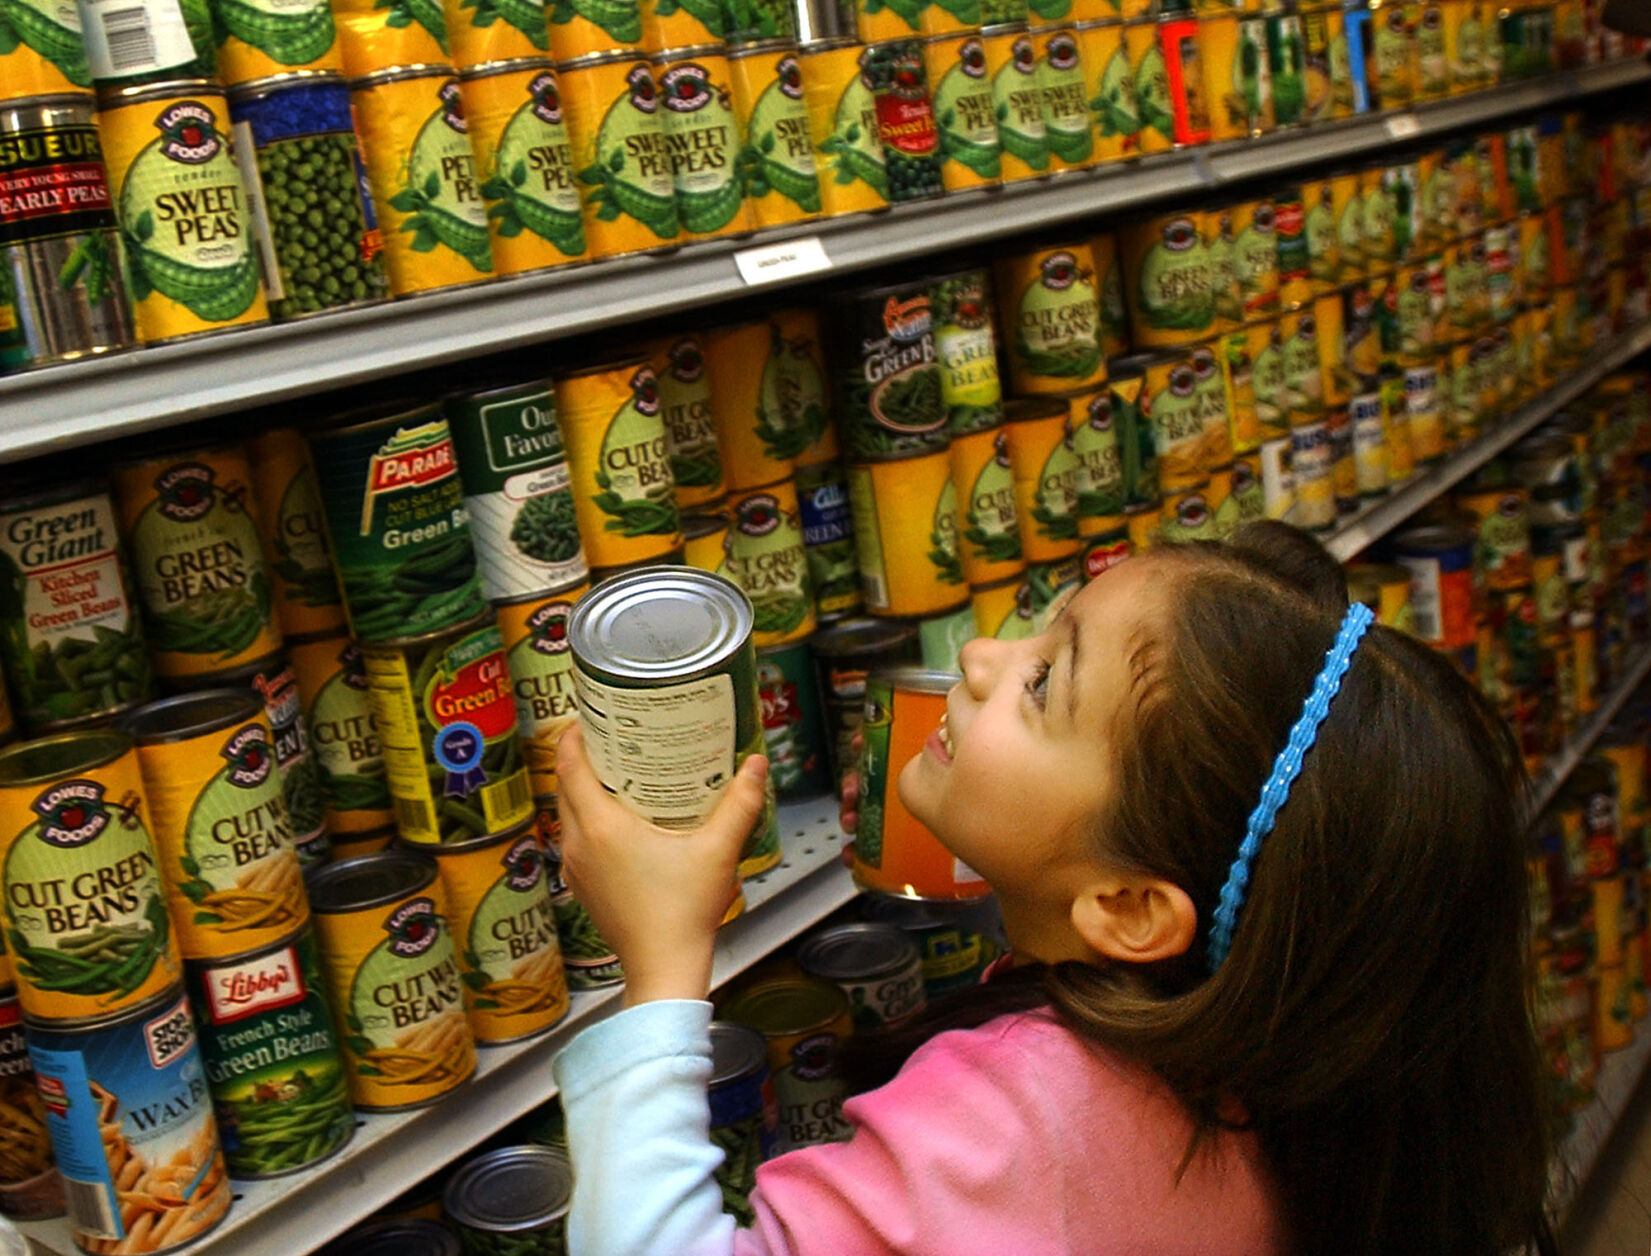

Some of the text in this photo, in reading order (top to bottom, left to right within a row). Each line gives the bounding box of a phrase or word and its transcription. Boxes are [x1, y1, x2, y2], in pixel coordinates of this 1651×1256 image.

[1010, 89, 1043, 109] SWE
[162, 106, 212, 128] LOWES
[776, 117, 811, 140] SWE
[0, 134, 100, 166] SUEUR
[168, 139, 219, 158] FOODS
[528, 144, 571, 170] SWE
[625, 132, 665, 157] SWE
[788, 136, 814, 159] PEA
[671, 149, 727, 176] PEAS
[455, 178, 481, 203] PE
[543, 167, 577, 191] PEA
[0, 185, 107, 214] EARLY PEAS
[155, 185, 240, 222] SWEET
[175, 211, 241, 247] PEAS
[864, 343, 922, 383] GREEN
[944, 344, 993, 371] GREE
[951, 362, 999, 387] BEAN
[673, 419, 716, 444] BEAN
[379, 445, 450, 485] PARADE
[606, 440, 648, 470] CUT
[161, 467, 211, 489] LOWES
[638, 463, 671, 487] BEA
[168, 496, 214, 518] FOODS
[8, 507, 96, 545] Green
[286, 512, 320, 537] CU
[383, 520, 448, 549] Green
[804, 523, 844, 543] REEN
[20, 527, 108, 568] Giant
[156, 541, 244, 578] GREEN
[39, 569, 101, 593] Kitchen
[162, 562, 248, 604] BEANS
[51, 584, 98, 608] Sliced
[28, 606, 79, 629] Green
[81, 598, 121, 621] Beans
[478, 660, 501, 684] Cut
[515, 672, 565, 700] CUT
[435, 687, 495, 717] Green
[531, 694, 579, 721] BEA
[228, 729, 266, 755] LOWES
[314, 715, 363, 744] CUT
[234, 759, 270, 783] FOODS
[41, 785, 98, 811] LOWES
[46, 813, 106, 842] FOODS
[212, 804, 269, 845] CUT
[232, 821, 295, 866] BEAN
[10, 850, 154, 909] CUT GREEN
[46, 886, 139, 934] BEANS
[390, 902, 433, 928] LOWES
[395, 925, 438, 952] FOODS
[492, 909, 539, 941] CUT
[508, 921, 557, 960] BEAN
[221, 965, 291, 1004] Libby's
[373, 970, 430, 1009] CUT
[392, 983, 461, 1029] BEANS
[216, 1009, 314, 1051] French Style
[0, 1057, 31, 1077] een
[205, 1030, 332, 1083] Green Beans
[782, 1103, 808, 1126] UT
[790, 1117, 847, 1143] BEAN
